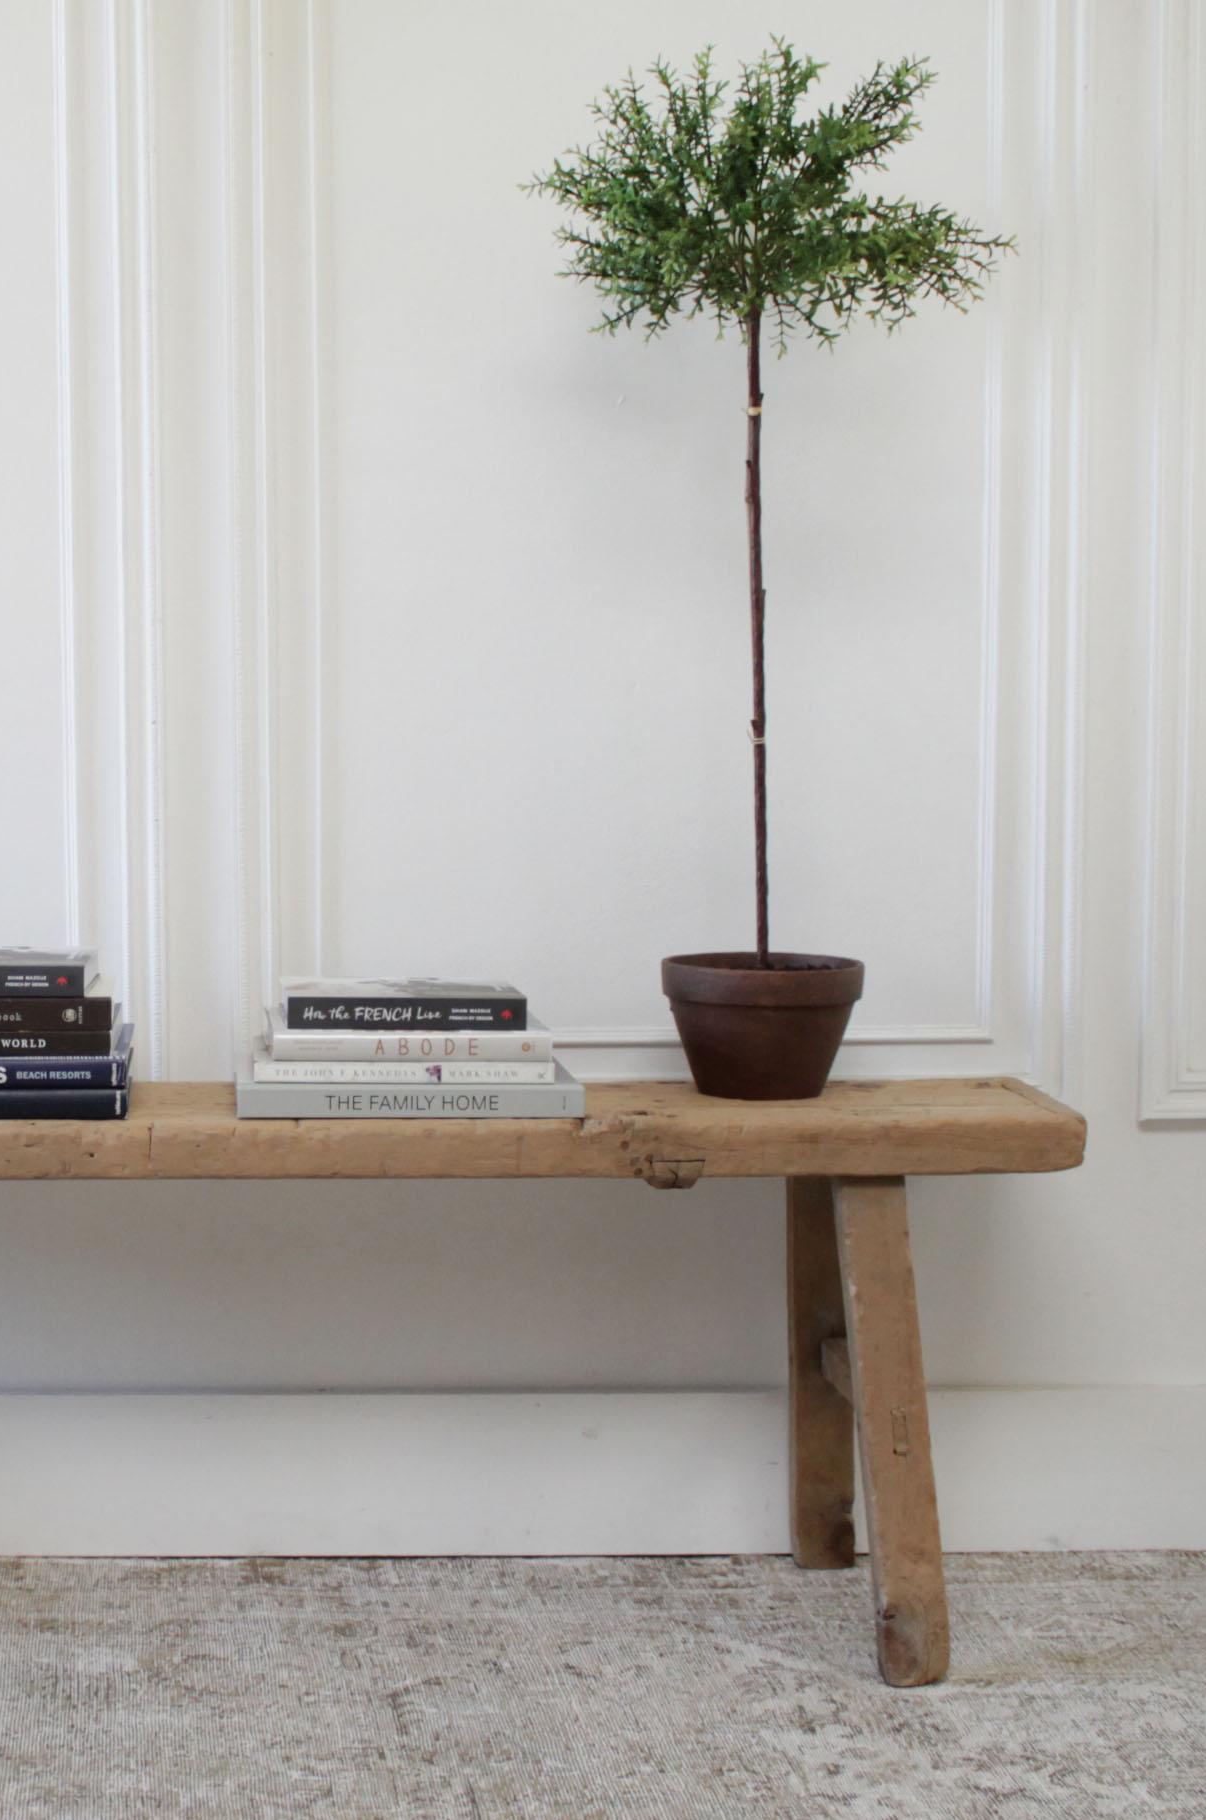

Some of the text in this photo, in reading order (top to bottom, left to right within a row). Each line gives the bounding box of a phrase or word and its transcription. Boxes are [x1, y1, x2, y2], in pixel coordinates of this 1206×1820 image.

[303, 1005, 443, 1022] How the FRENCH Live
[0, 1038, 47, 1049] WORLD
[375, 1037, 480, 1056] ABODE
[16, 1069, 47, 1080] BEACH
[49, 1069, 92, 1080] RESORTS
[275, 1068, 299, 1077] THE
[303, 1068, 335, 1077] JOHN
[448, 1070, 480, 1078] MARK
[325, 1095, 499, 1111] THE FAMILY HOME
